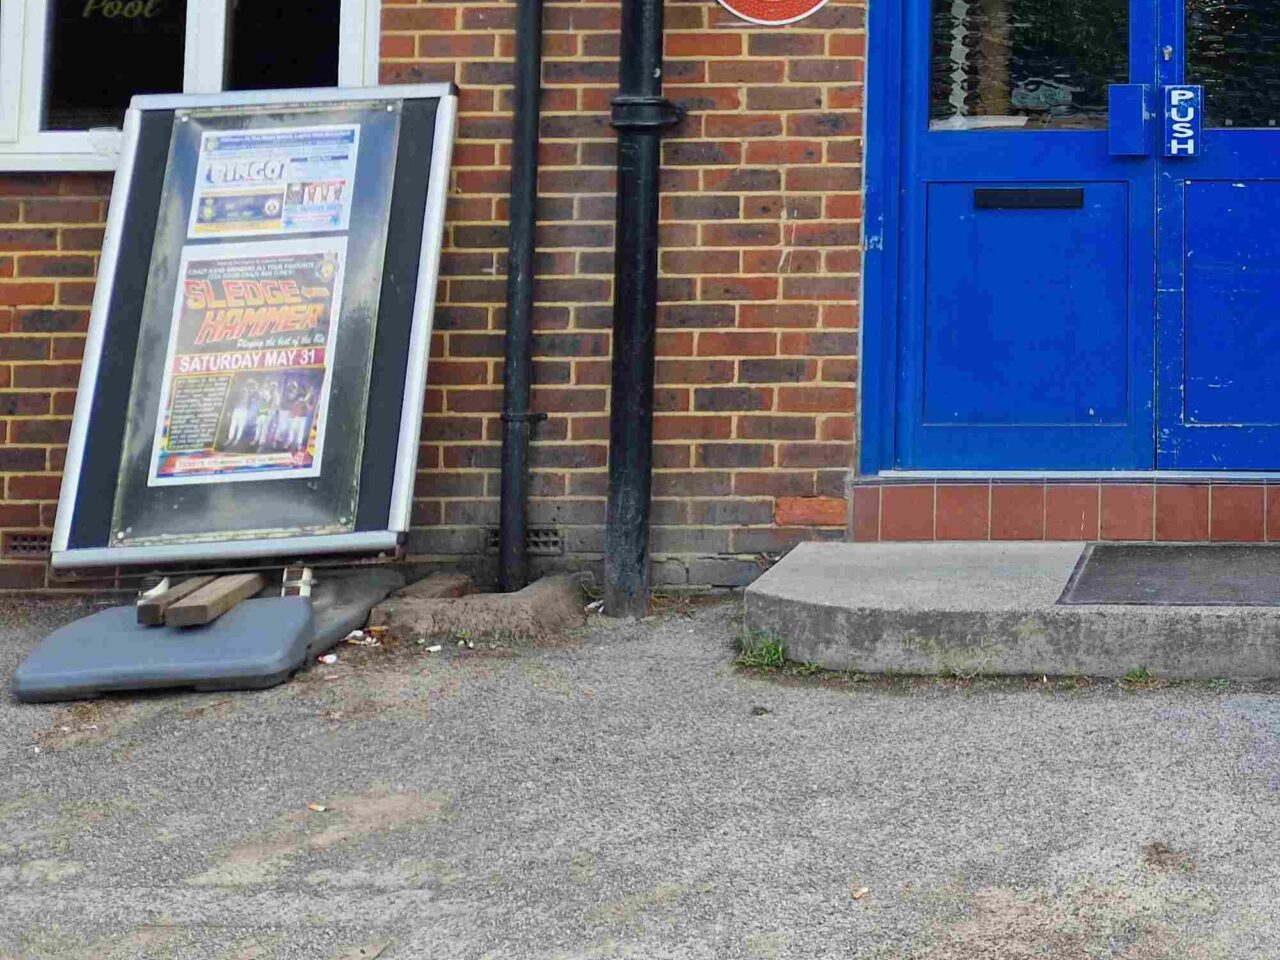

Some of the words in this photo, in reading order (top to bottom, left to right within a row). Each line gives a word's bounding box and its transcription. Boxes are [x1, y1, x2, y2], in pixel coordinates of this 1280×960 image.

[1171, 89, 1195, 155] PUSH
[184, 279, 302, 310] SLEDGE
[194, 303, 325, 345] HAMMER
[179, 353, 263, 373] SATURDAY
[264, 351, 297, 369] MAY
[300, 349, 316, 365] 31
